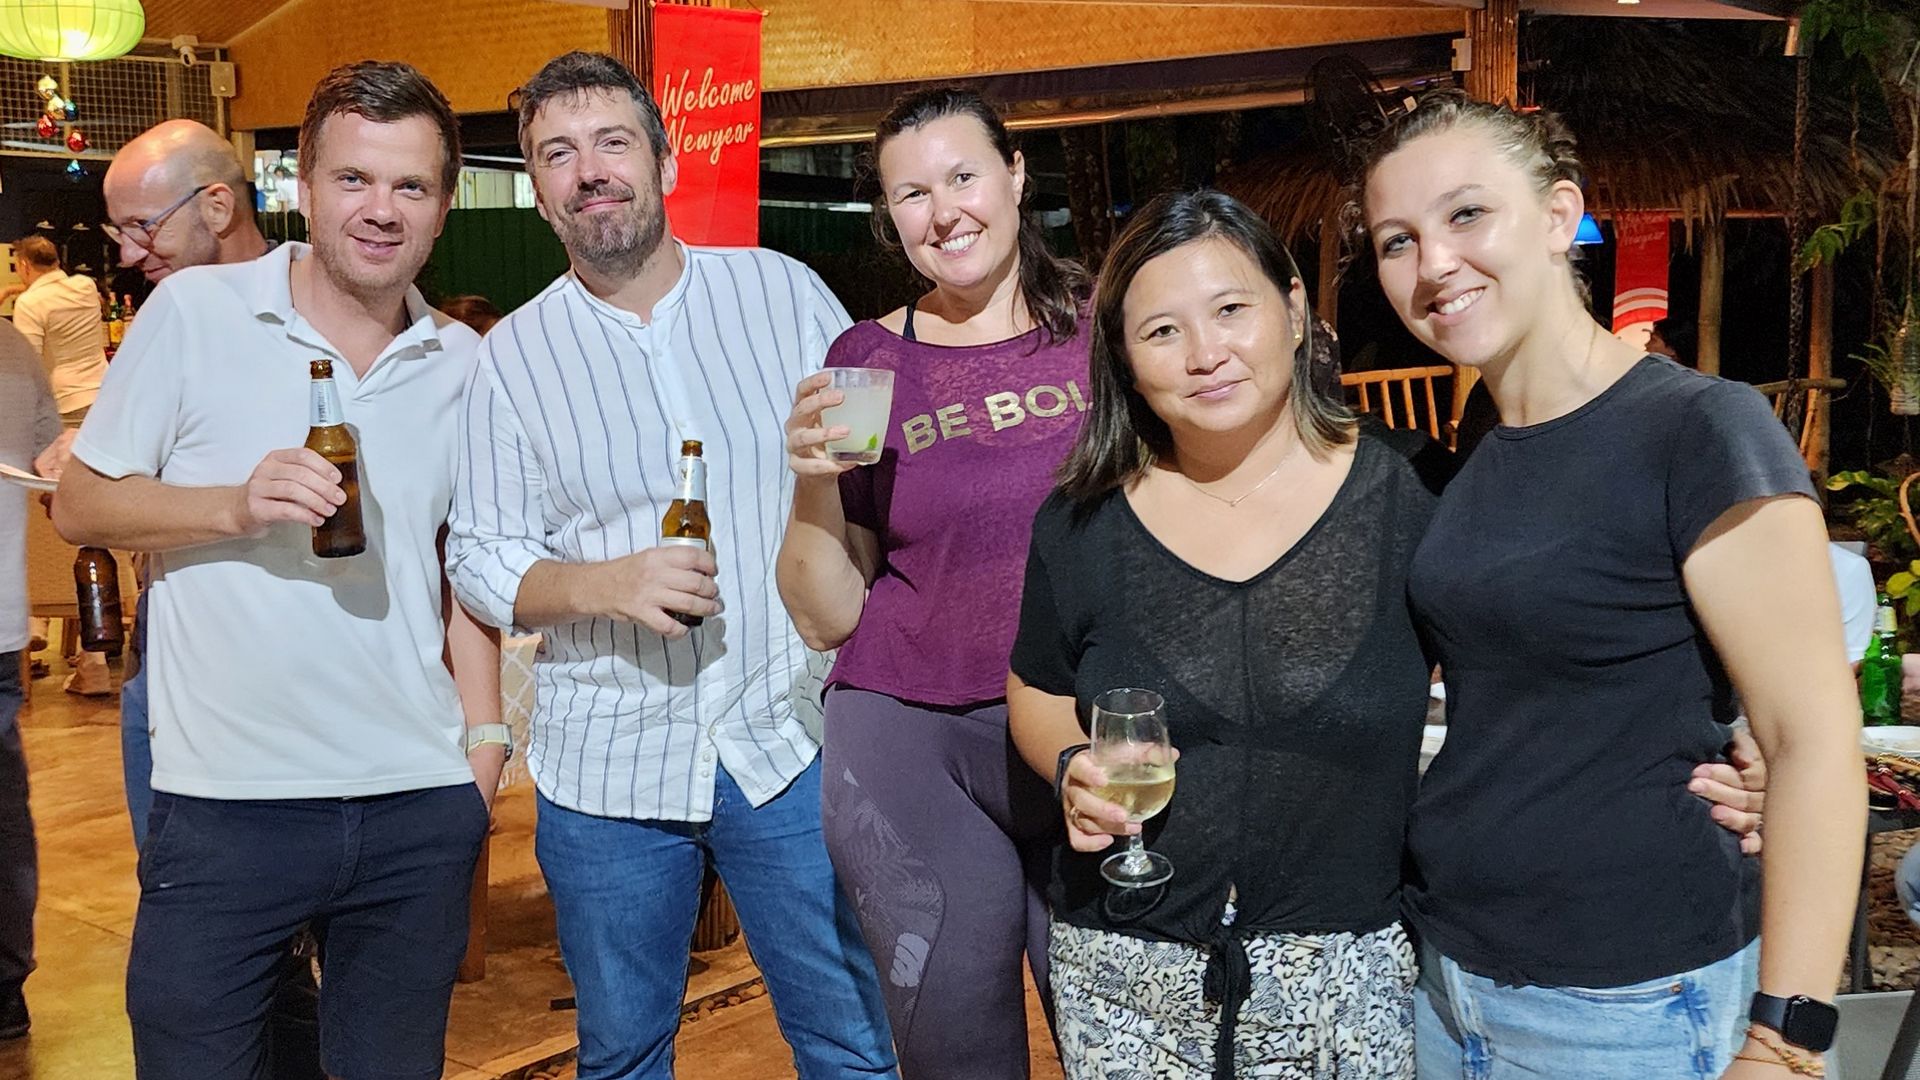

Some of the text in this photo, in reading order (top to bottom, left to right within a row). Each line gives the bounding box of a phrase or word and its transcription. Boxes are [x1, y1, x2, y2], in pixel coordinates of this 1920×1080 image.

[661, 67, 756, 120] Welcome
[667, 115, 755, 166] Newyear
[902, 380, 1093, 455] BE BOL
